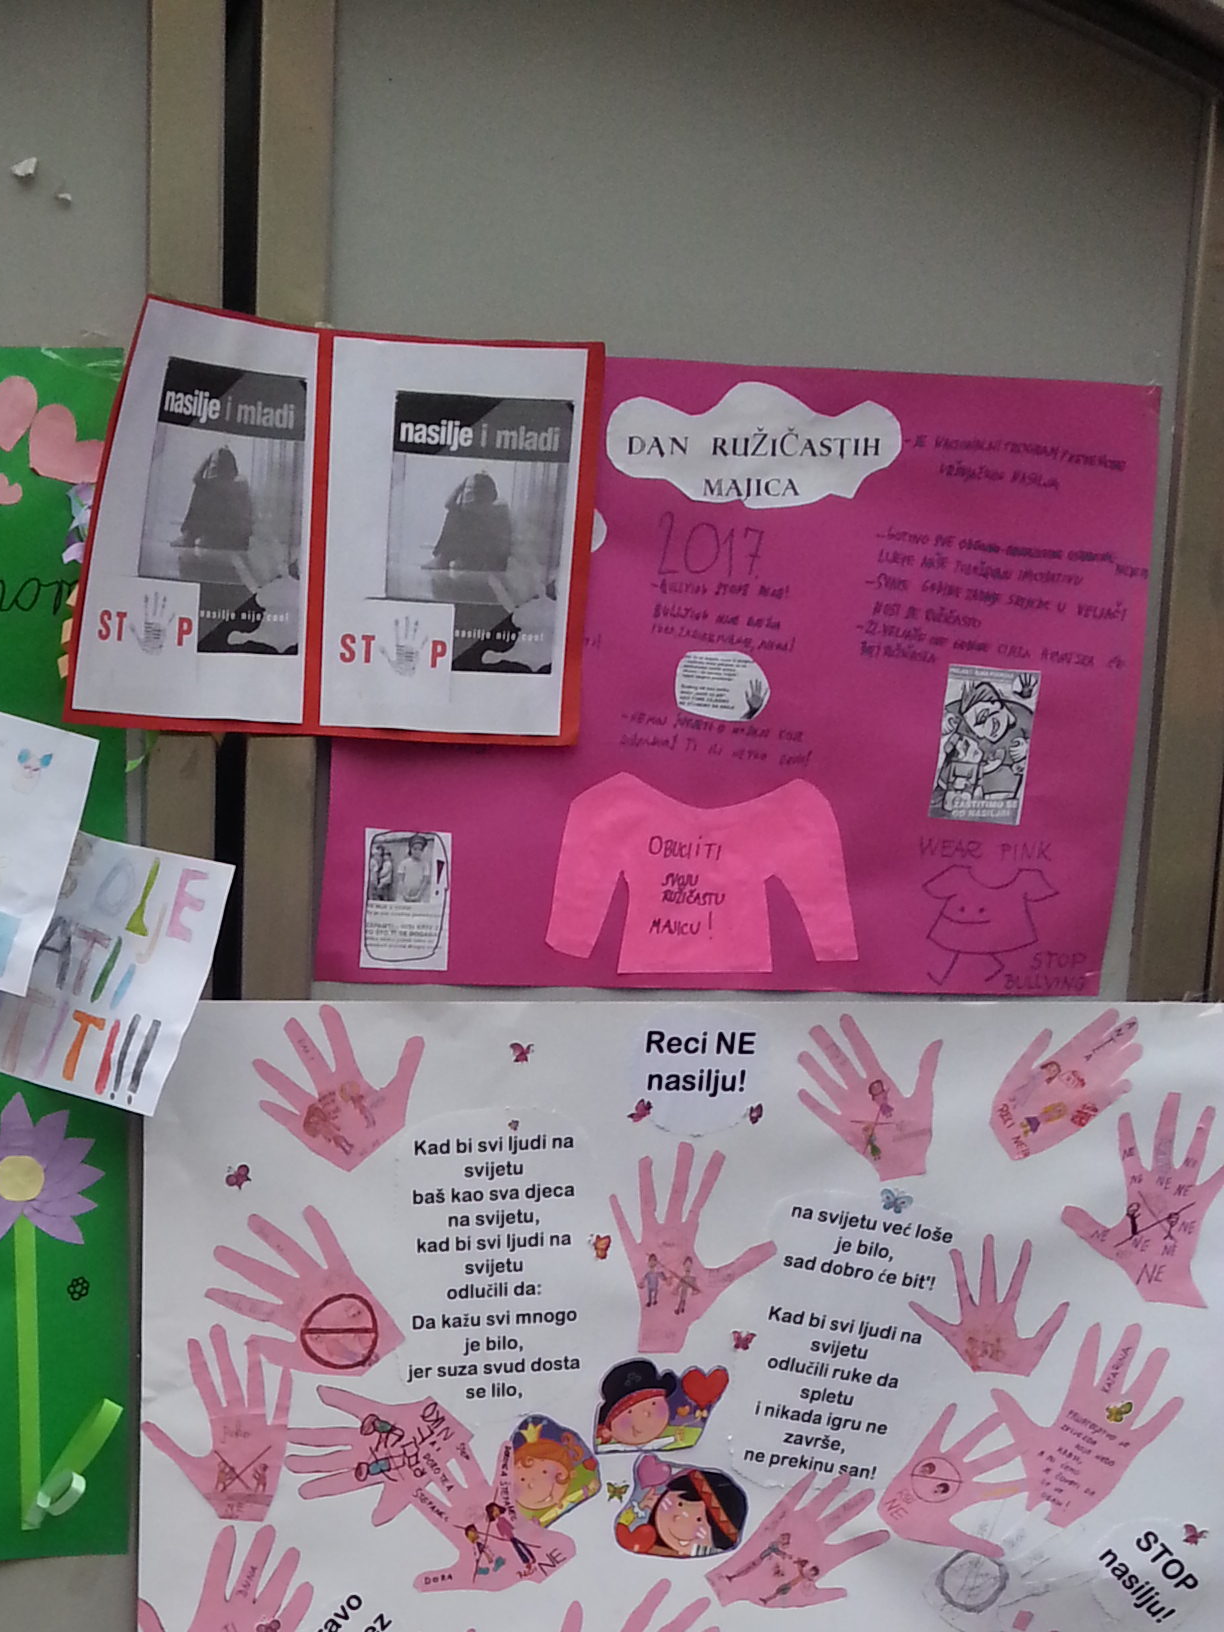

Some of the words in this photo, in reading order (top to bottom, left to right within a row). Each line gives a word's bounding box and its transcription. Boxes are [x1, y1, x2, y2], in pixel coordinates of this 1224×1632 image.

[163, 388, 221, 421] nasilje
[225, 395, 231, 421] i
[236, 403, 295, 431] mladi
[399, 419, 473, 452] nasilje
[480, 424, 488, 448] i
[496, 424, 561, 452] mladi
[628, 436, 689, 458] DAN
[711, 429, 881, 459] RUŽIČASTIH
[703, 478, 800, 500] MAJICA
[645, 1030, 708, 1055] Reci
[716, 1031, 757, 1055] NE
[647, 1068, 746, 1098] nasilju!
[414, 1138, 451, 1156] Kad
[456, 1137, 473, 1154] bi
[477, 1136, 503, 1153] svi
[508, 1134, 547, 1155] ljudi
[552, 1136, 574, 1149] na
[464, 1161, 524, 1181] svijetu
[412, 1188, 446, 1205] baš
[451, 1187, 484, 1203] kao
[489, 1188, 520, 1202] sva
[524, 1183, 575, 1203] djeca
[448, 1215, 470, 1228] na
[475, 1208, 540, 1229] svijetu,
[791, 1206, 814, 1220] na
[817, 1210, 878, 1231] svijetu
[882, 1221, 912, 1237] već
[914, 1223, 953, 1244] loše
[416, 1236, 450, 1253] kad
[455, 1235, 471, 1252] bi
[476, 1234, 501, 1251] svi
[506, 1231, 544, 1253] ljudi
[549, 1233, 572, 1247] na
[833, 1239, 852, 1255] je
[856, 1239, 893, 1263] bilo,
[465, 1257, 523, 1278] svijetu
[783, 1255, 817, 1271] sad
[820, 1259, 874, 1281] dobro
[877, 1272, 897, 1285] će
[901, 1271, 936, 1291] bit'!
[446, 1281, 508, 1300] odlučili
[513, 1281, 541, 1297] da:
[412, 1315, 436, 1330] Da
[441, 1313, 481, 1329] kažu
[486, 1310, 510, 1327] svi
[515, 1310, 578, 1327] mnogo
[768, 1305, 806, 1326] Kad
[808, 1312, 827, 1329] bi
[829, 1319, 856, 1334] svi
[858, 1320, 898, 1341] ljudi
[899, 1331, 922, 1345] na
[463, 1340, 481, 1357] je
[486, 1335, 524, 1352] bilo,
[809, 1340, 869, 1365] svijetu
[406, 1364, 433, 1383] jer
[437, 1364, 478, 1378] suza
[483, 1358, 526, 1375] svud
[530, 1355, 580, 1372] dosta
[767, 1356, 829, 1378] odlučili
[831, 1367, 873, 1385] ruke
[876, 1372, 899, 1389] da
[465, 1387, 486, 1400] se
[491, 1382, 523, 1399] lilo,
[799, 1387, 854, 1407] spletu
[754, 1400, 761, 1416] i
[764, 1404, 823, 1425] nikada
[826, 1415, 862, 1431] igru
[865, 1422, 888, 1435] ne
[783, 1432, 845, 1455] završe,
[743, 1449, 766, 1463] ne
[768, 1453, 835, 1473] prekinu
[838, 1464, 877, 1480] san!
[538, 1549, 567, 1576] NE
[1135, 1530, 1199, 1593] STOP
[1098, 1548, 1176, 1625] nasilju!
